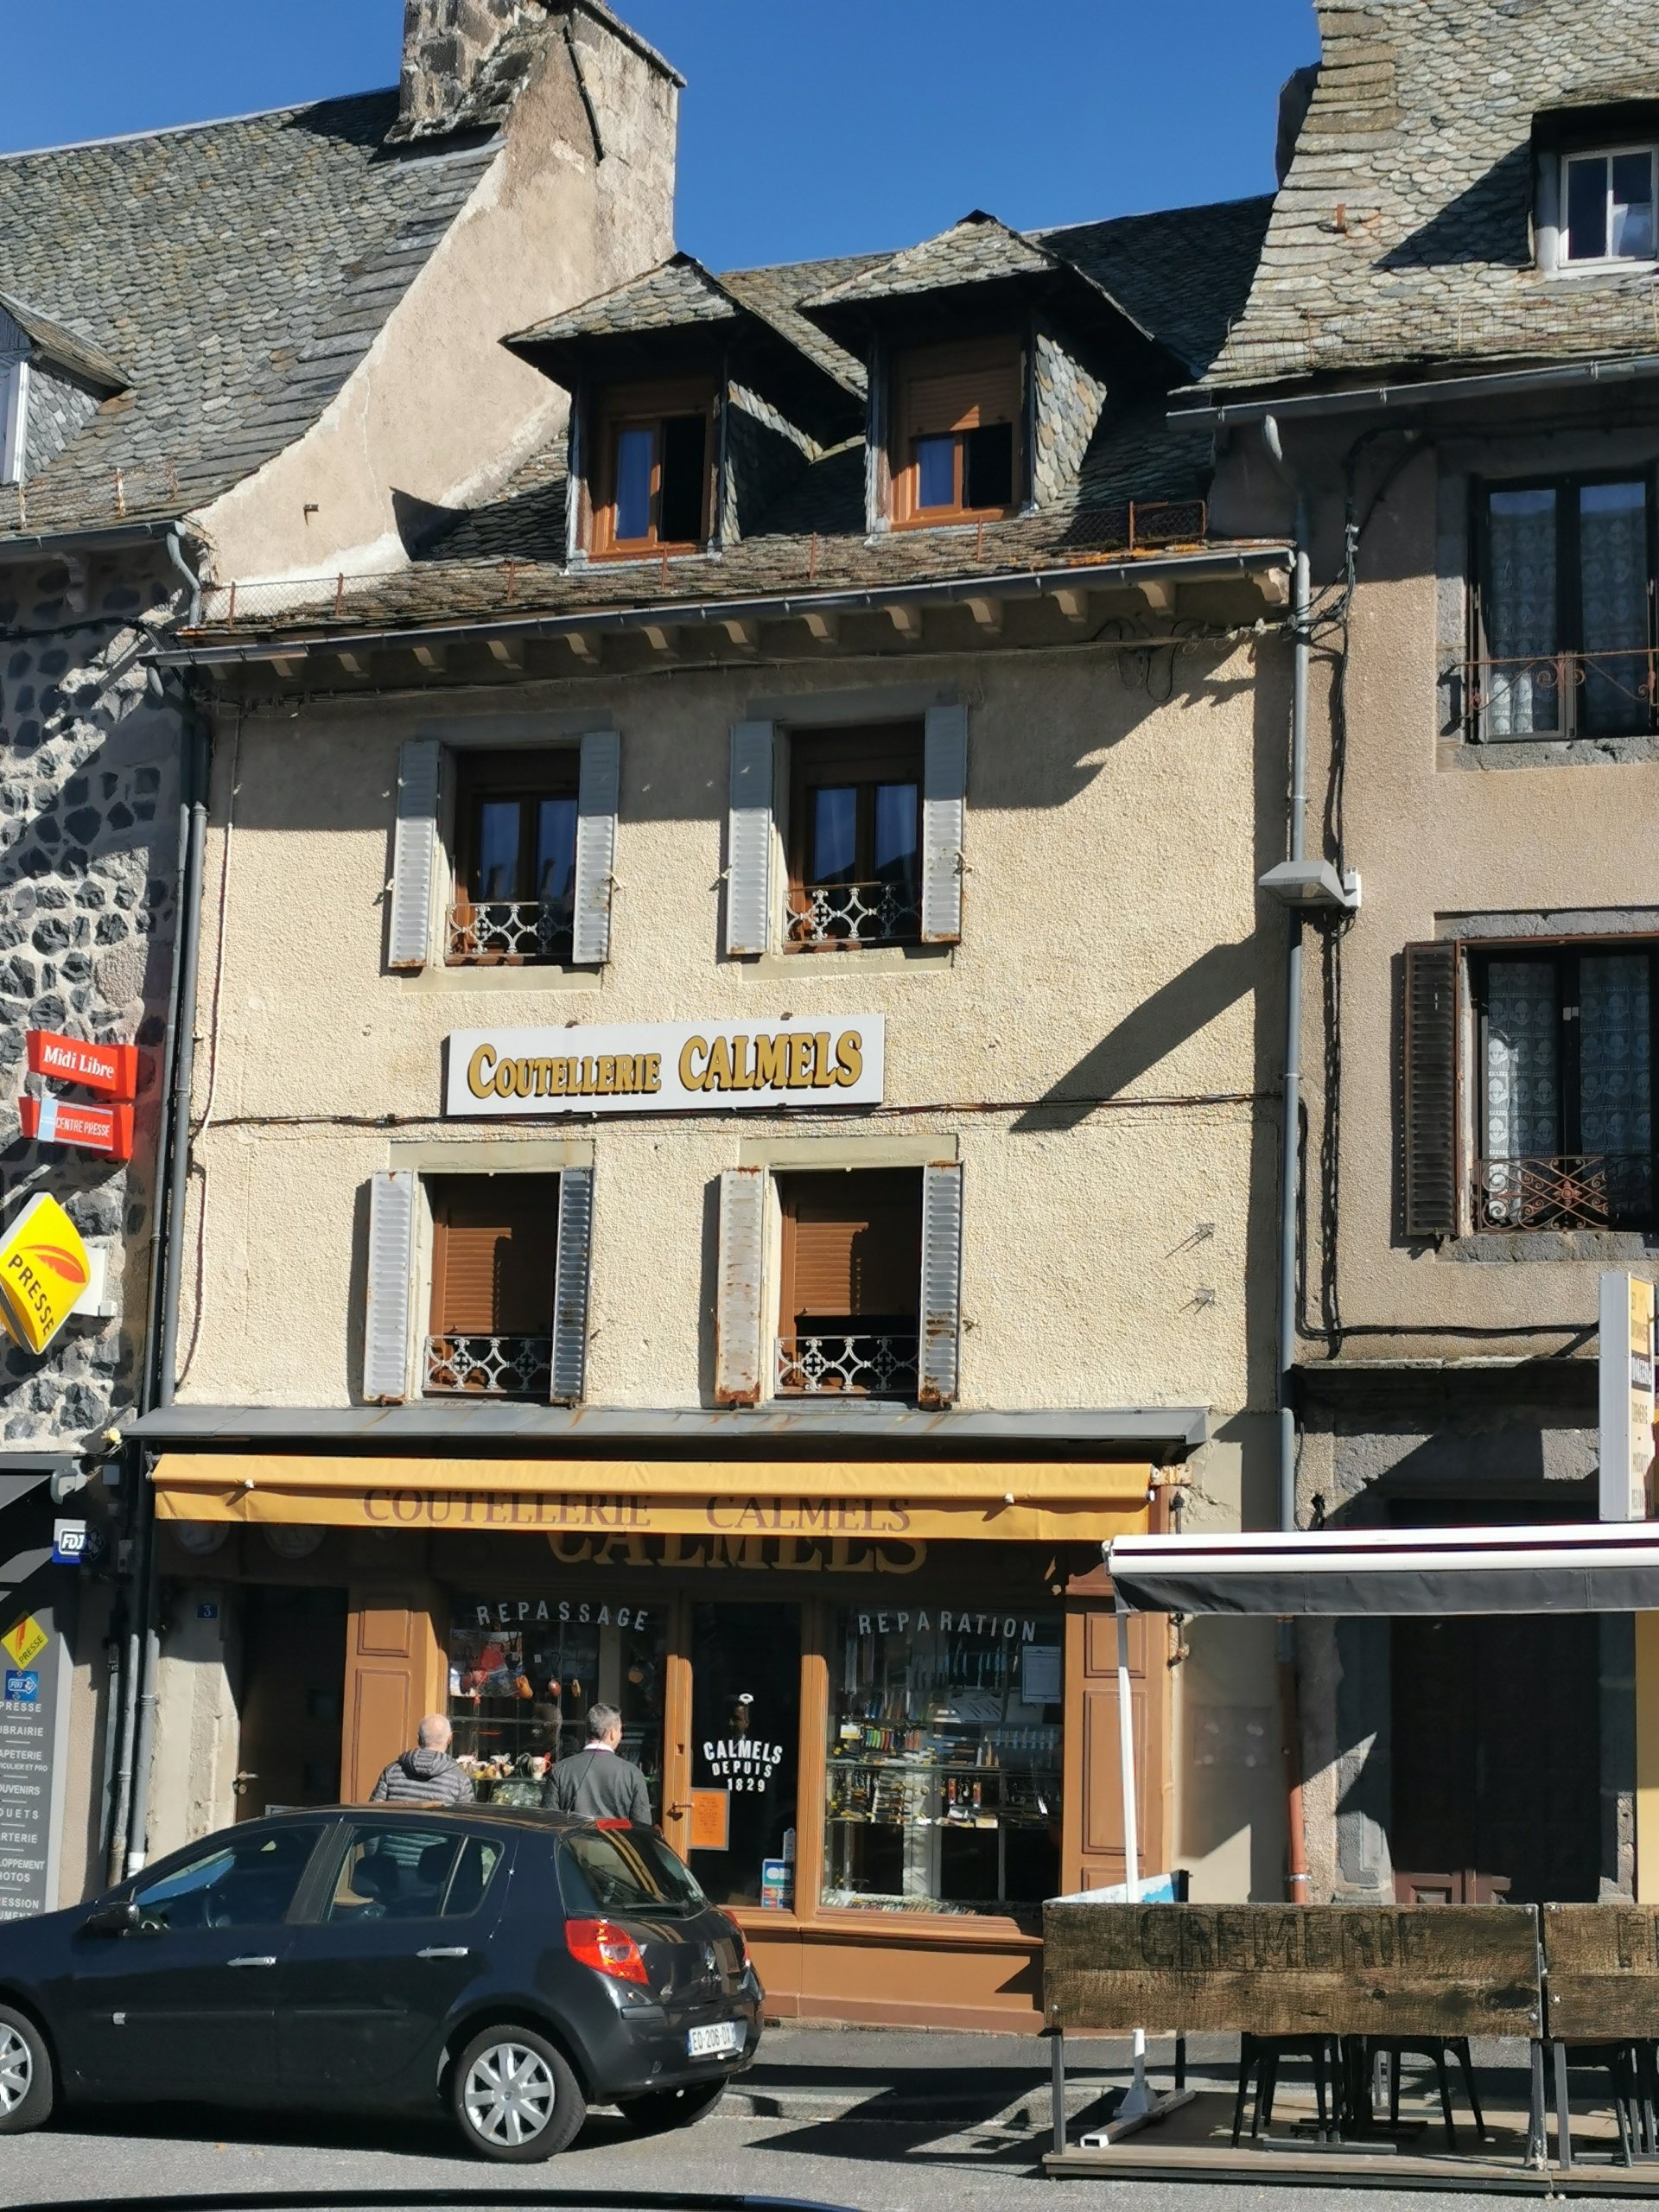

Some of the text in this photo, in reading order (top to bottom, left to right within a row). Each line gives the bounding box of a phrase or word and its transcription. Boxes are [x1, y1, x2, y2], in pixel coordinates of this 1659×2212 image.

[43, 1045, 114, 1078] Midi Libre
[467, 1030, 863, 1099] COUTELLERIE CALMELS
[56, 1117, 83, 1134] CENTRE
[84, 1122, 111, 1137] PRESSE
[8, 1254, 54, 1336] PRESSE
[363, 1489, 912, 1533] COUTELLERIE CALMELS
[61, 1533, 86, 1550] FDJ
[203, 1605, 212, 1618] 3
[476, 1600, 649, 1632] REPASSAGE
[858, 1611, 1037, 1642] REPARATION
[18, 1634, 45, 1664] PRESSE
[0, 1725, 43, 1737] IBRAIRIE
[0, 1749, 42, 1761] APETERIE
[703, 1740, 784, 1764] CALMELS
[712, 1761, 772, 1778] DEPUIS
[727, 1777, 766, 1793] 1829
[0, 1808, 39, 1820] OUETS
[0, 1833, 38, 1844] RTERIE
[0, 1897, 39, 1910] ESSION
